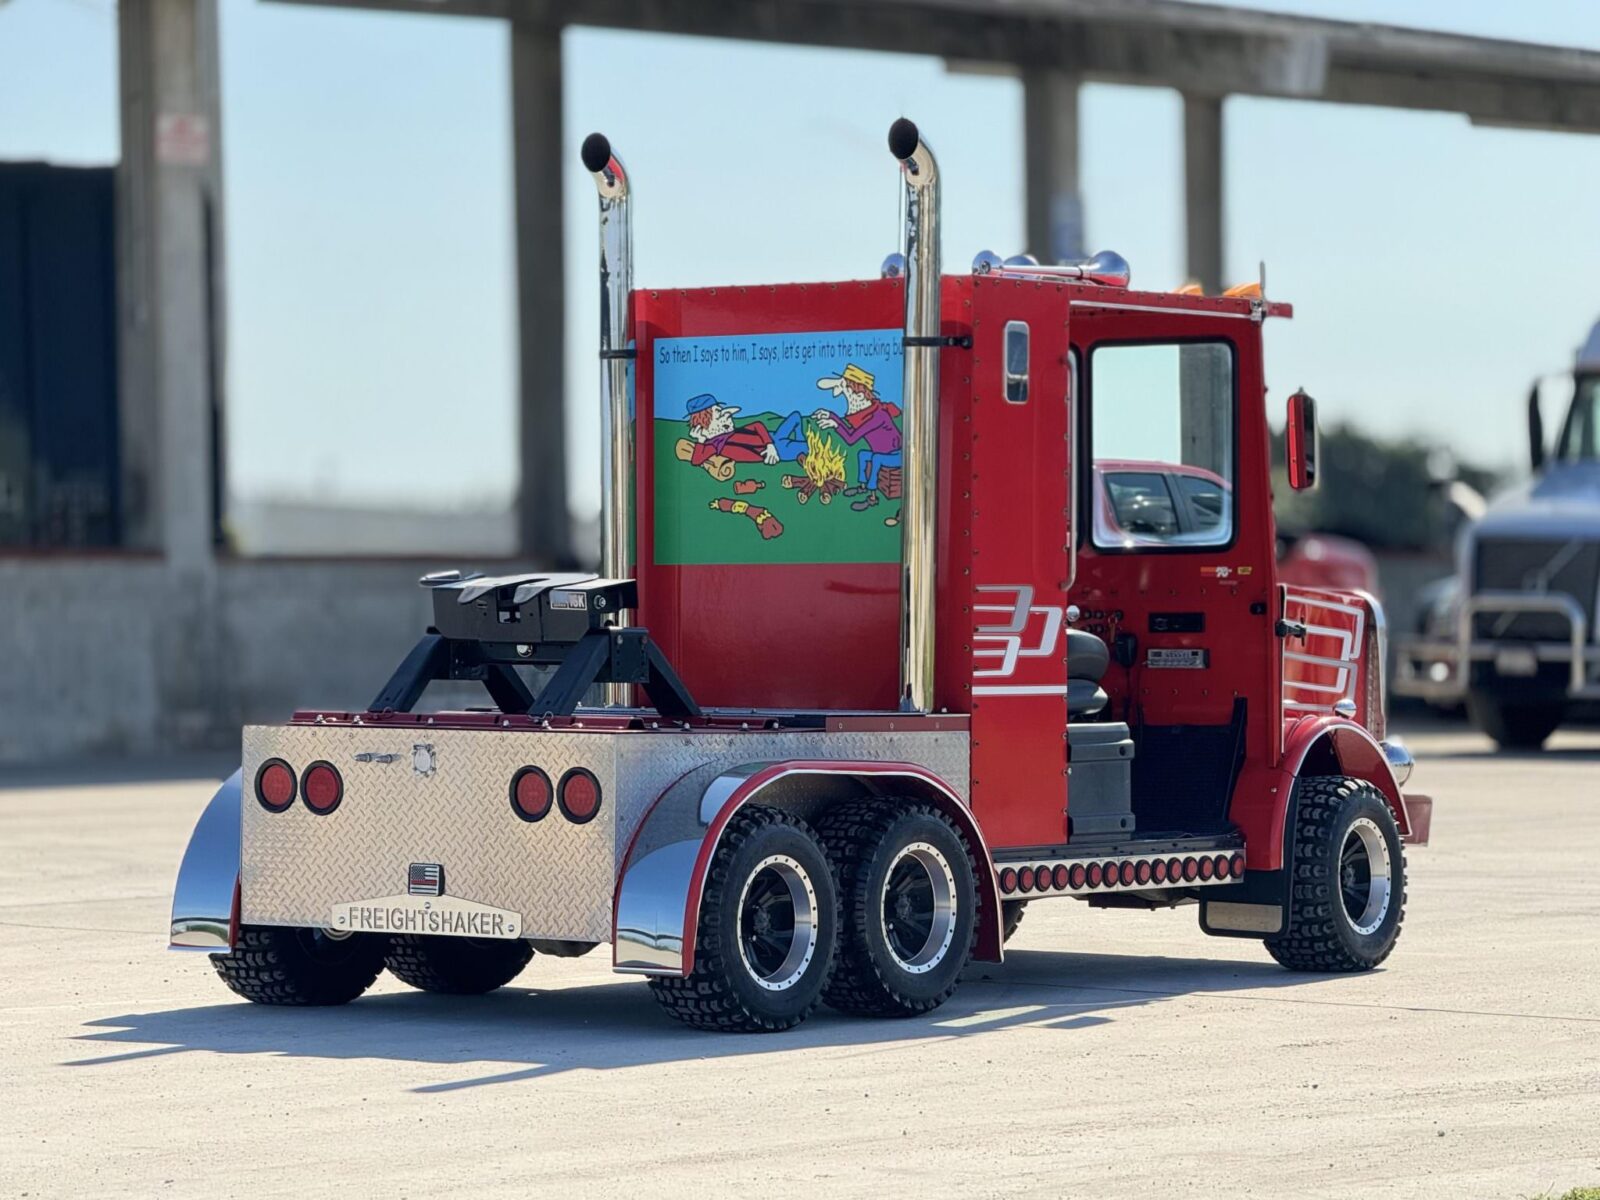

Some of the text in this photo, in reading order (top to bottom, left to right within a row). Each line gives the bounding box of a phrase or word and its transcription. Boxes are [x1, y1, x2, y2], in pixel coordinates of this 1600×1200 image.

[659, 346, 671, 364] So
[672, 345, 691, 363] then
[693, 345, 699, 363] I
[701, 347, 719, 368] says
[721, 345, 730, 362] to
[732, 342, 750, 365] him,
[751, 342, 757, 361] I
[759, 345, 780, 366] says,
[782, 340, 800, 360] let's
[802, 341, 816, 365] get
[819, 340, 835, 358] into
[837, 338, 852, 358] the
[855, 336, 890, 361] trucking
[349, 907, 504, 935] FREIGHTSHAKER
